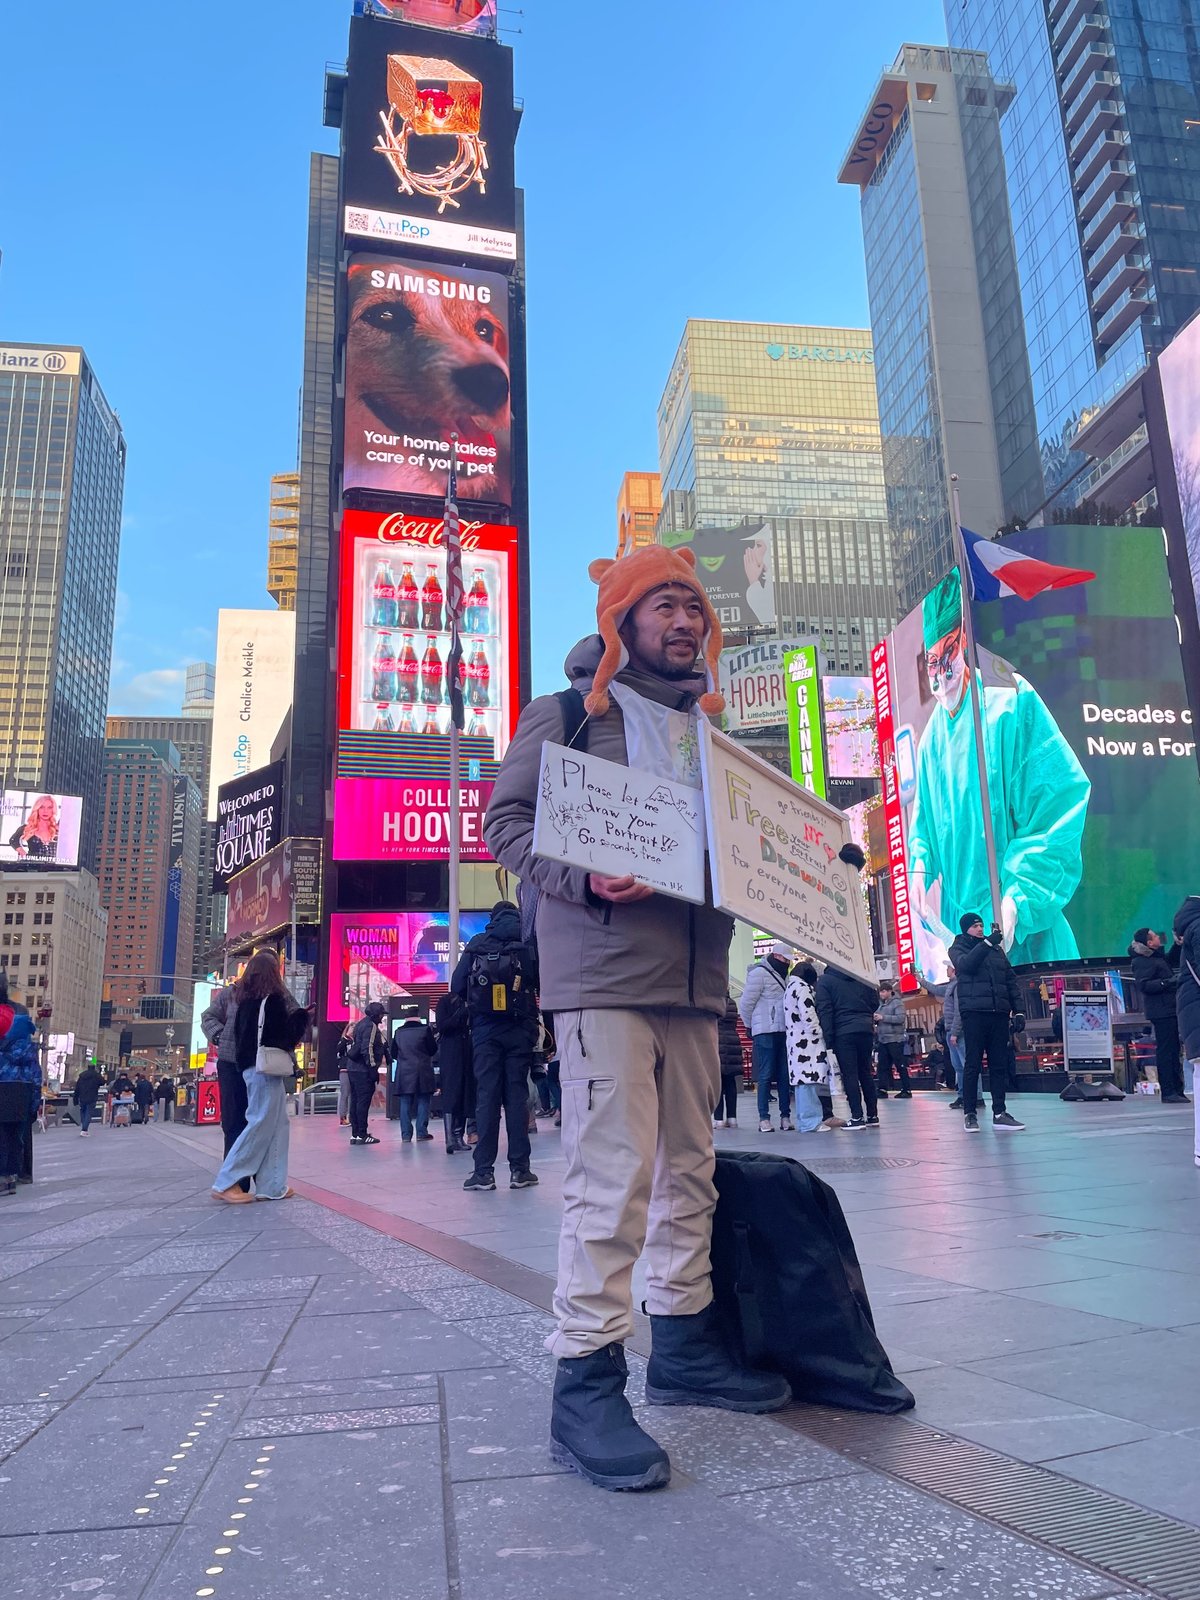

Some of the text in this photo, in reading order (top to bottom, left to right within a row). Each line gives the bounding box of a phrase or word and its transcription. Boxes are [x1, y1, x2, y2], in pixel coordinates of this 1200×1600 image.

[373, 215, 430, 239] ArtPop
[467, 234, 479, 243] Jill
[370, 270, 491, 304] SAMSUNG
[0, 353, 39, 367] ianz
[788, 344, 874, 364] BARCLAYS
[364, 430, 497, 457] Your home takes
[366, 450, 405, 464] care
[410, 453, 425, 467] of
[467, 461, 494, 476] pet
[378, 511, 486, 551] Coca-Cla
[729, 644, 778, 676] LITTLE
[239, 641, 255, 722] Chalice Meikle
[875, 661, 890, 723] STORE
[1082, 703, 1176, 724] Decades
[796, 684, 815, 795] CANNA
[1086, 736, 1196, 757] Now a For
[403, 788, 480, 807] COLLEN
[561, 757, 659, 814] Please let me
[219, 784, 275, 816] WELCOME TO
[581, 795, 620, 819] draw
[725, 768, 790, 846] Free
[239, 806, 274, 836] TIMES
[383, 811, 487, 842] HOOVE
[803, 823, 824, 846] NY
[577, 827, 596, 845] 60
[790, 833, 811, 850] your
[215, 826, 272, 876] SQUARE
[791, 845, 827, 873] portrait
[731, 844, 808, 904] for everyone
[759, 835, 848, 917] Drawing
[746, 878, 765, 902] 60
[888, 814, 913, 974] FREE CHOCOLATE
[346, 927, 398, 943] WOMAN
[795, 926, 824, 948] from
[351, 944, 392, 959] DOWN
